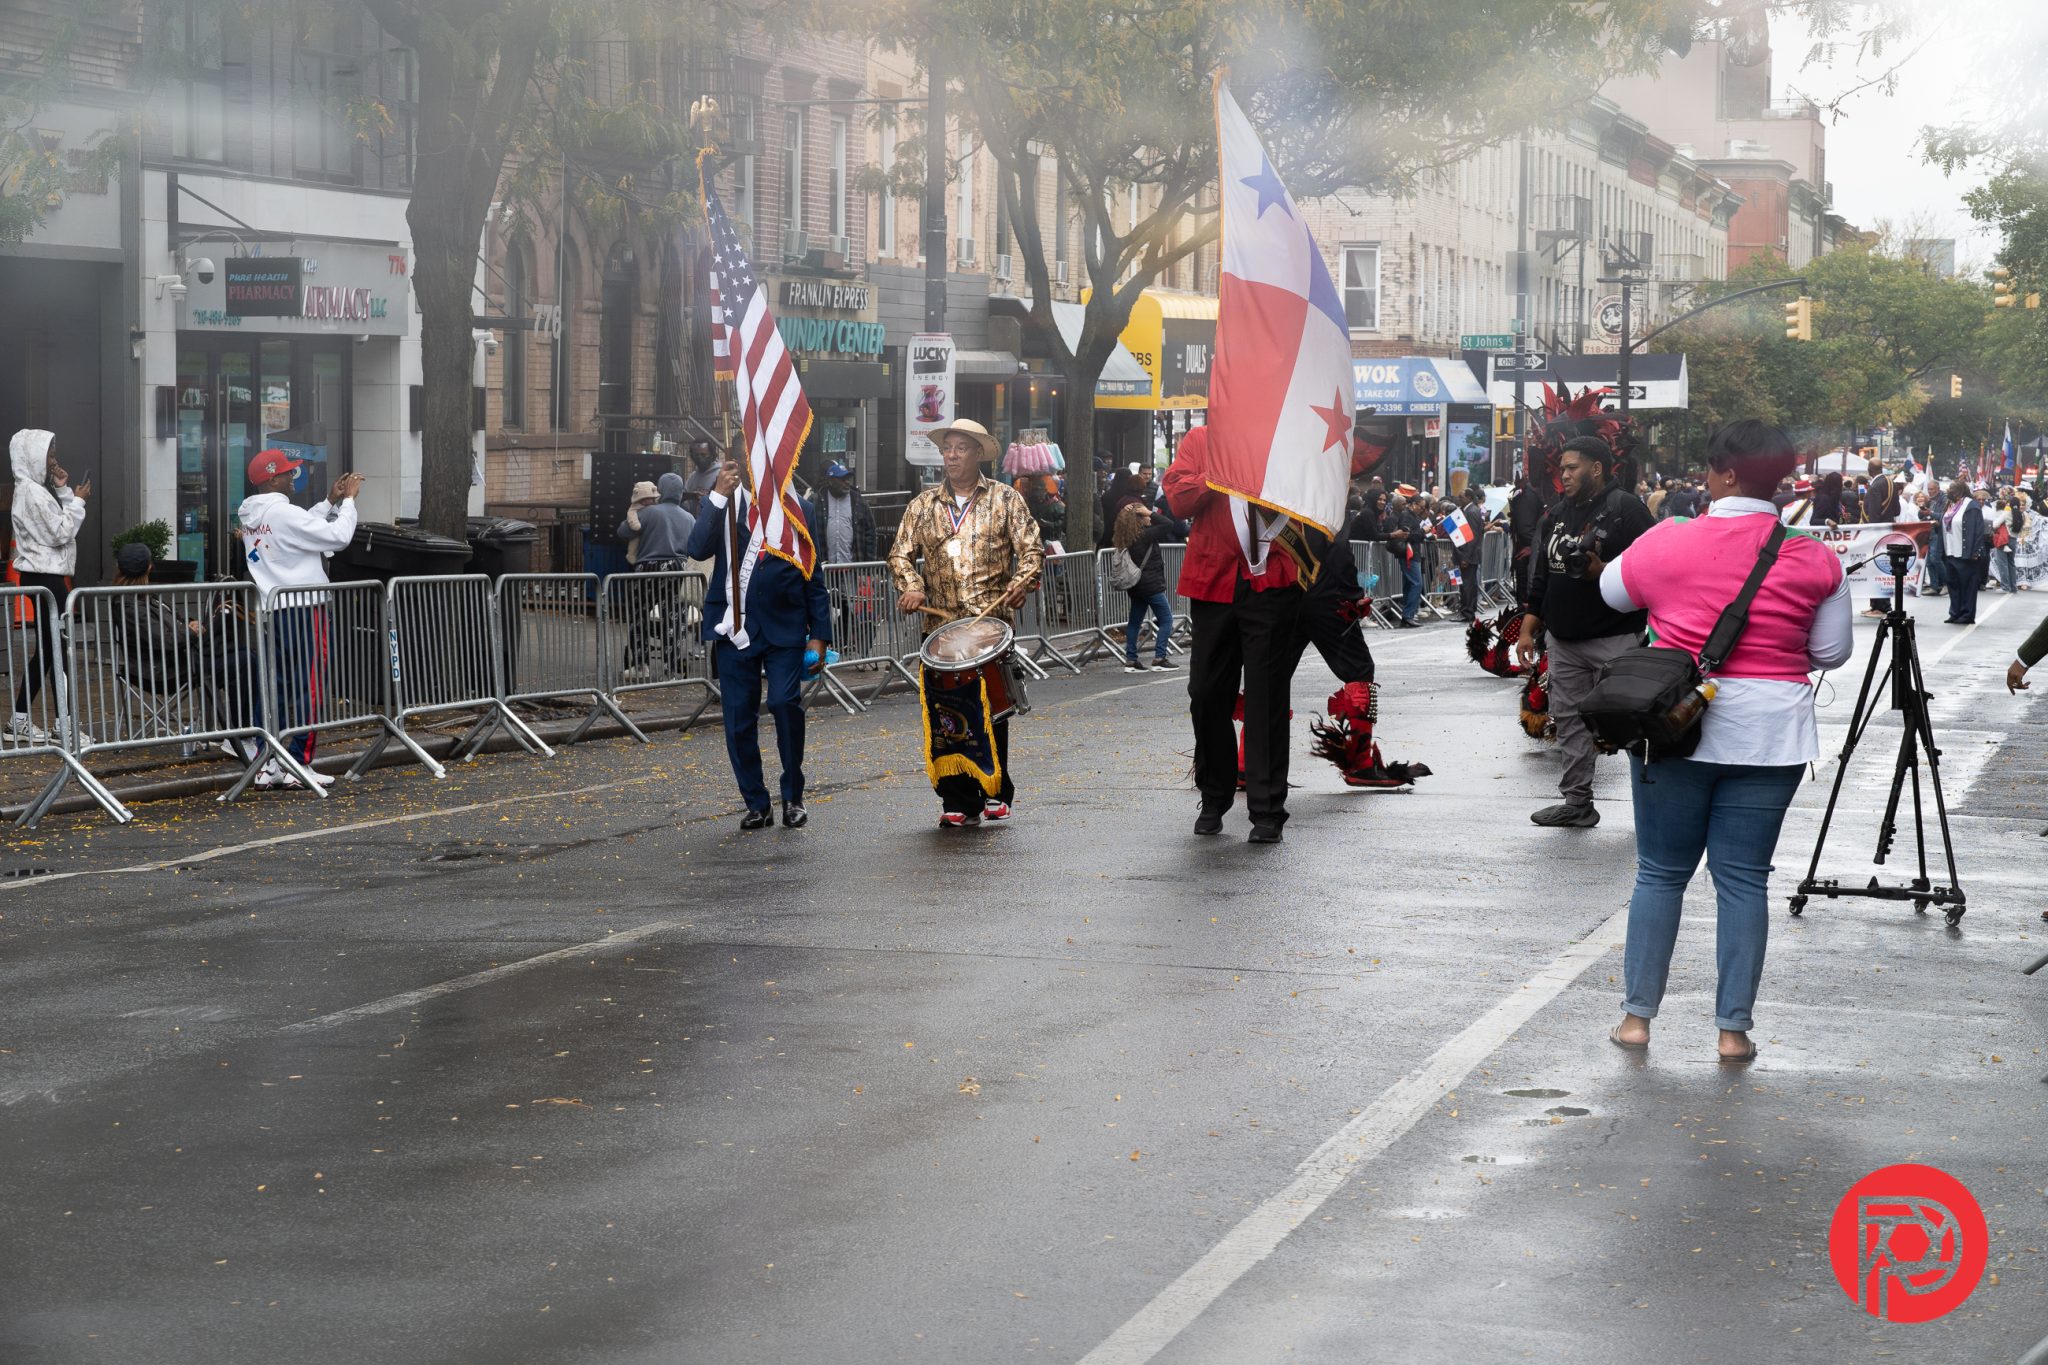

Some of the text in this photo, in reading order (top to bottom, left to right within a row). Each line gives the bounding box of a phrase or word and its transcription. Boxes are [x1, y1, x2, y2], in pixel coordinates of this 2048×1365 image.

[229, 273, 288, 282] PURE HEALTH
[228, 285, 295, 300] PHARMACY
[789, 282, 869, 310] FRANKLIN EXPRESS
[302, 285, 387, 320] ARMACY LLC
[778, 316, 885, 354] AUNDRY CENTER
[1463, 336, 1471, 347] St
[1476, 336, 1504, 347] Johns
[913, 346, 951, 361] LUCKY
[1186, 344, 1207, 373] DUALS
[1353, 365, 1401, 384] WOK
[1364, 389, 1382, 398] TAKE
[1384, 389, 1401, 398] OUT
[1410, 403, 1435, 412] CHINESE
[389, 631, 399, 679] NYPD
